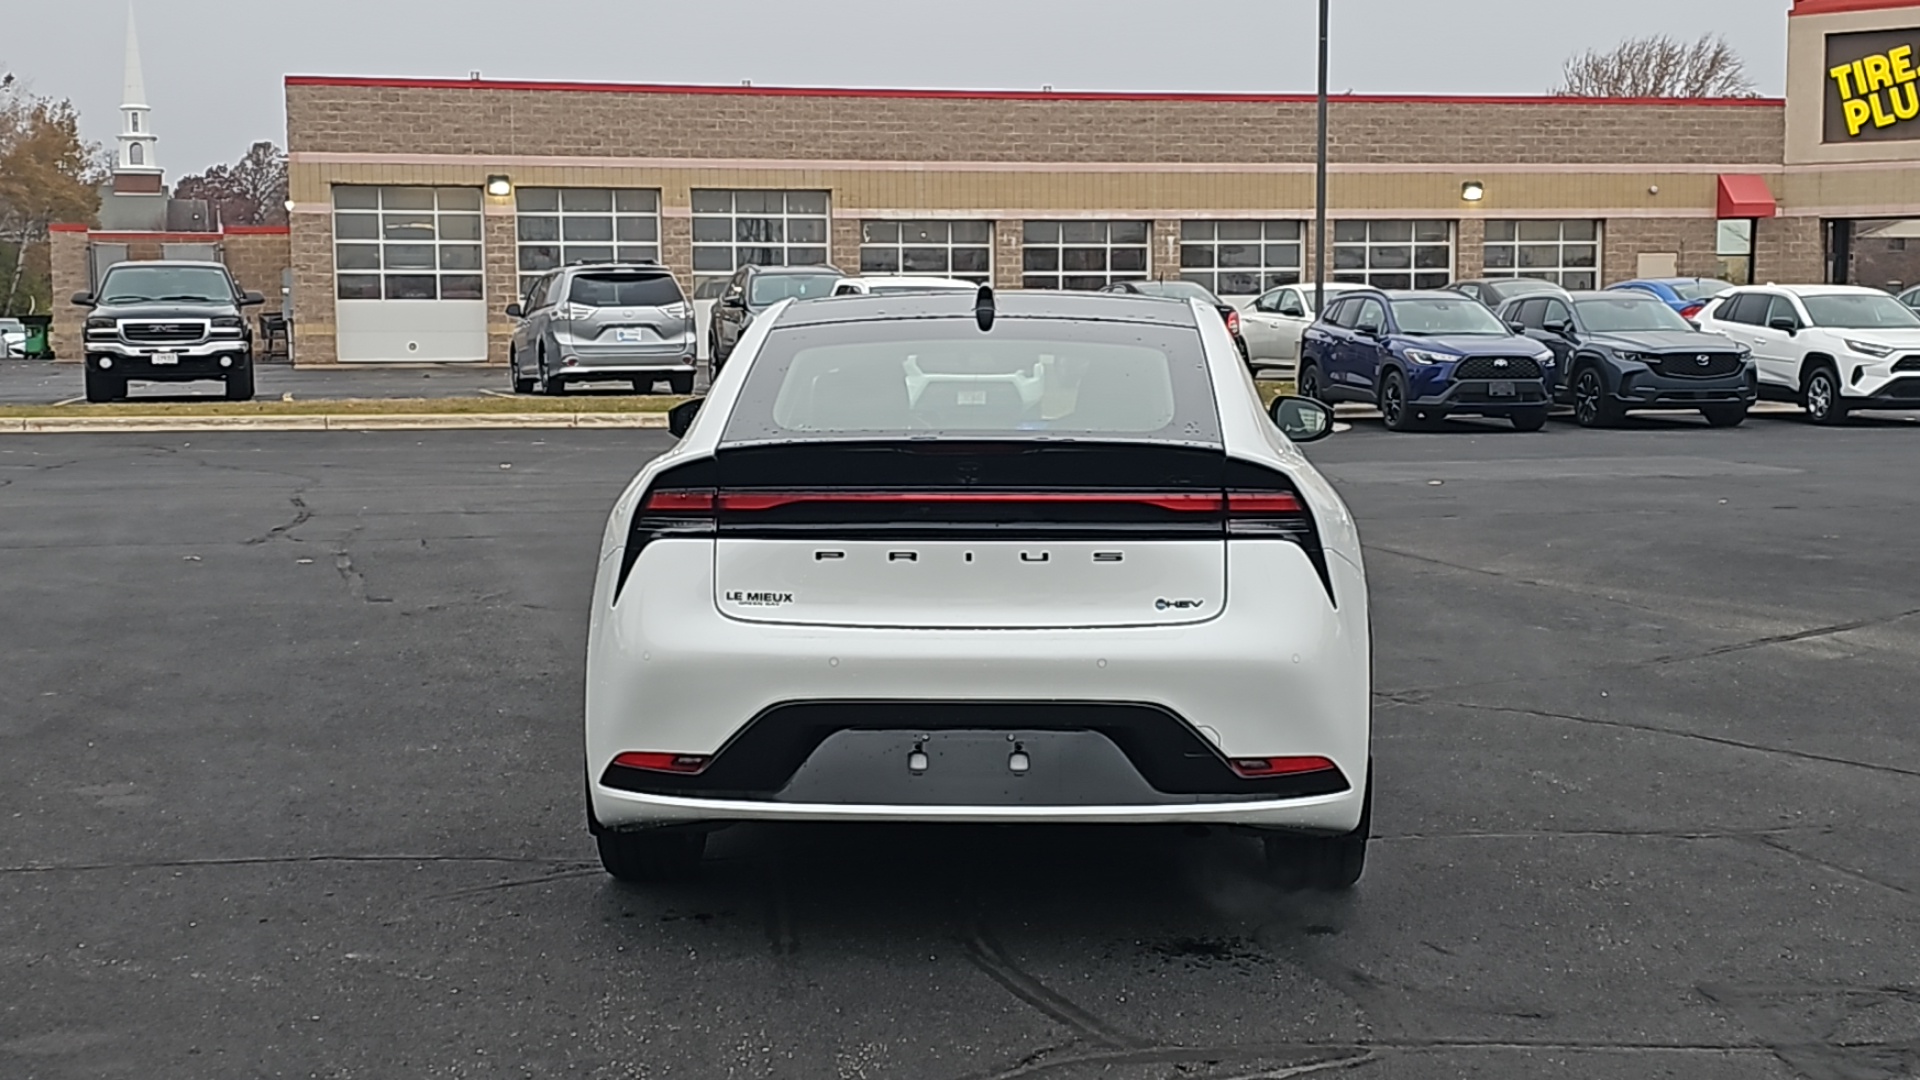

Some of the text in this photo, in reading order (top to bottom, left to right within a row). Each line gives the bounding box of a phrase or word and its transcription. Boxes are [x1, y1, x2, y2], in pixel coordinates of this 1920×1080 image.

[1829, 44, 1920, 101] TIRE
[1842, 81, 1920, 136] PLU
[815, 551, 1123, 562] PRIUS
[726, 591, 793, 603] LE MIEUX
